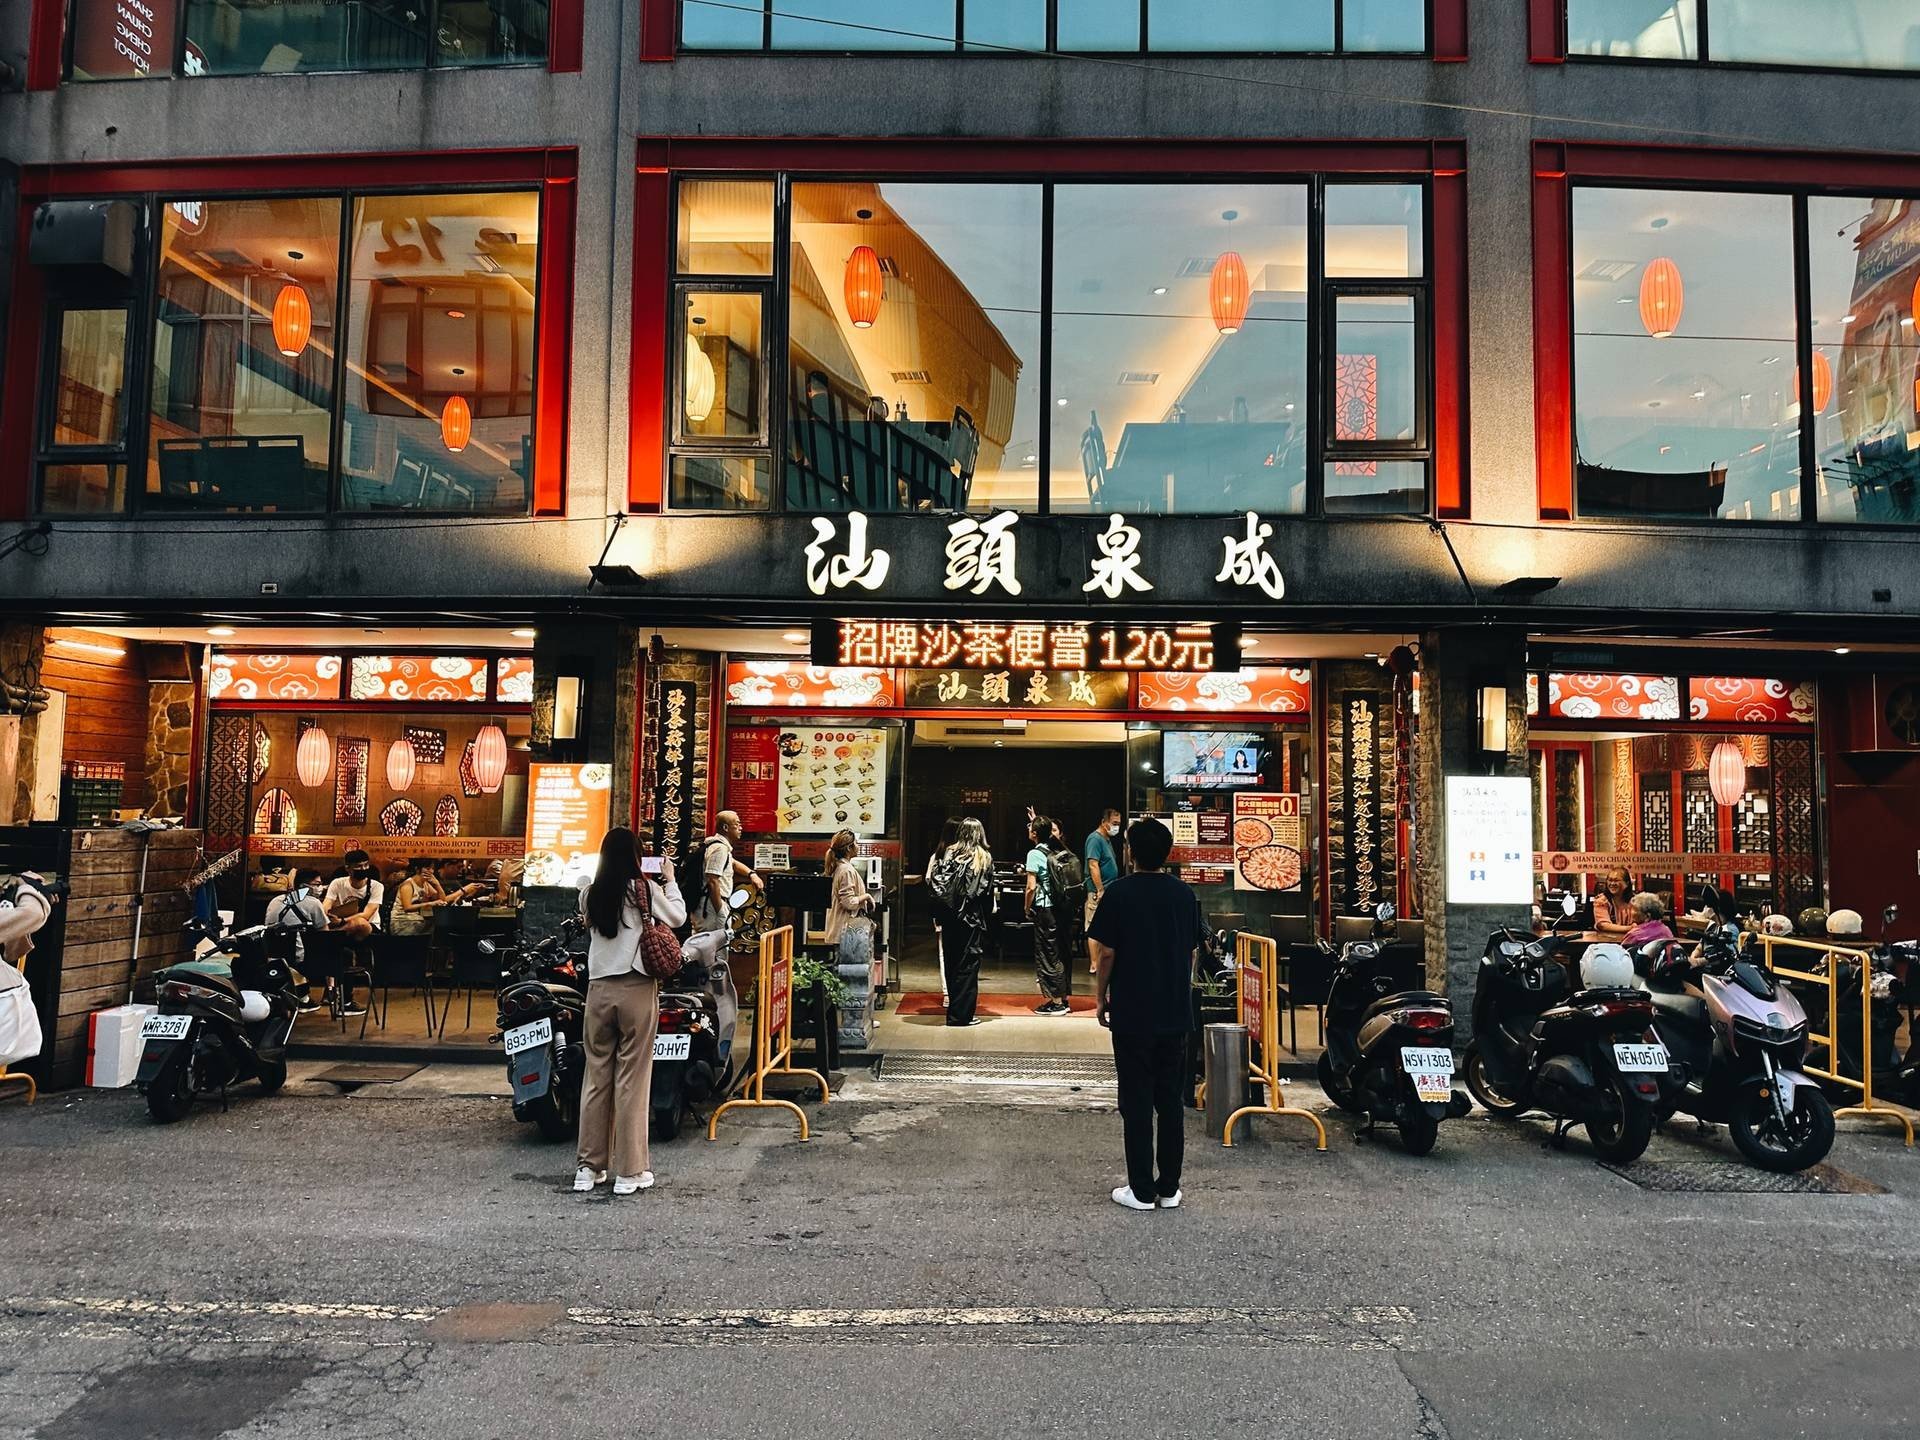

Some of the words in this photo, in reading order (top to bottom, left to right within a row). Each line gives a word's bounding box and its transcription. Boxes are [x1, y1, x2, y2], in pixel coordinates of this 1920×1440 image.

[803, 510, 1286, 600] 汕頭泉成
[838, 622, 1090, 668] 招牌沙茶便當
[1099, 627, 1214, 670] 120元
[938, 670, 1098, 706] 汕頭泉成
[364, 839, 398, 848] SHANTOU
[399, 839, 425, 848] CHUAN
[425, 840, 451, 848] CHENG
[451, 840, 481, 848] HOTPOT
[1572, 855, 1606, 863] SHANTOU
[1606, 855, 1631, 863] CHUAN
[1631, 855, 1657, 863] CHENG
[1657, 856, 1686, 864] HOTPOT
[506, 1026, 550, 1051] 893-PMU
[1617, 1051, 1665, 1066] NEN-0510
